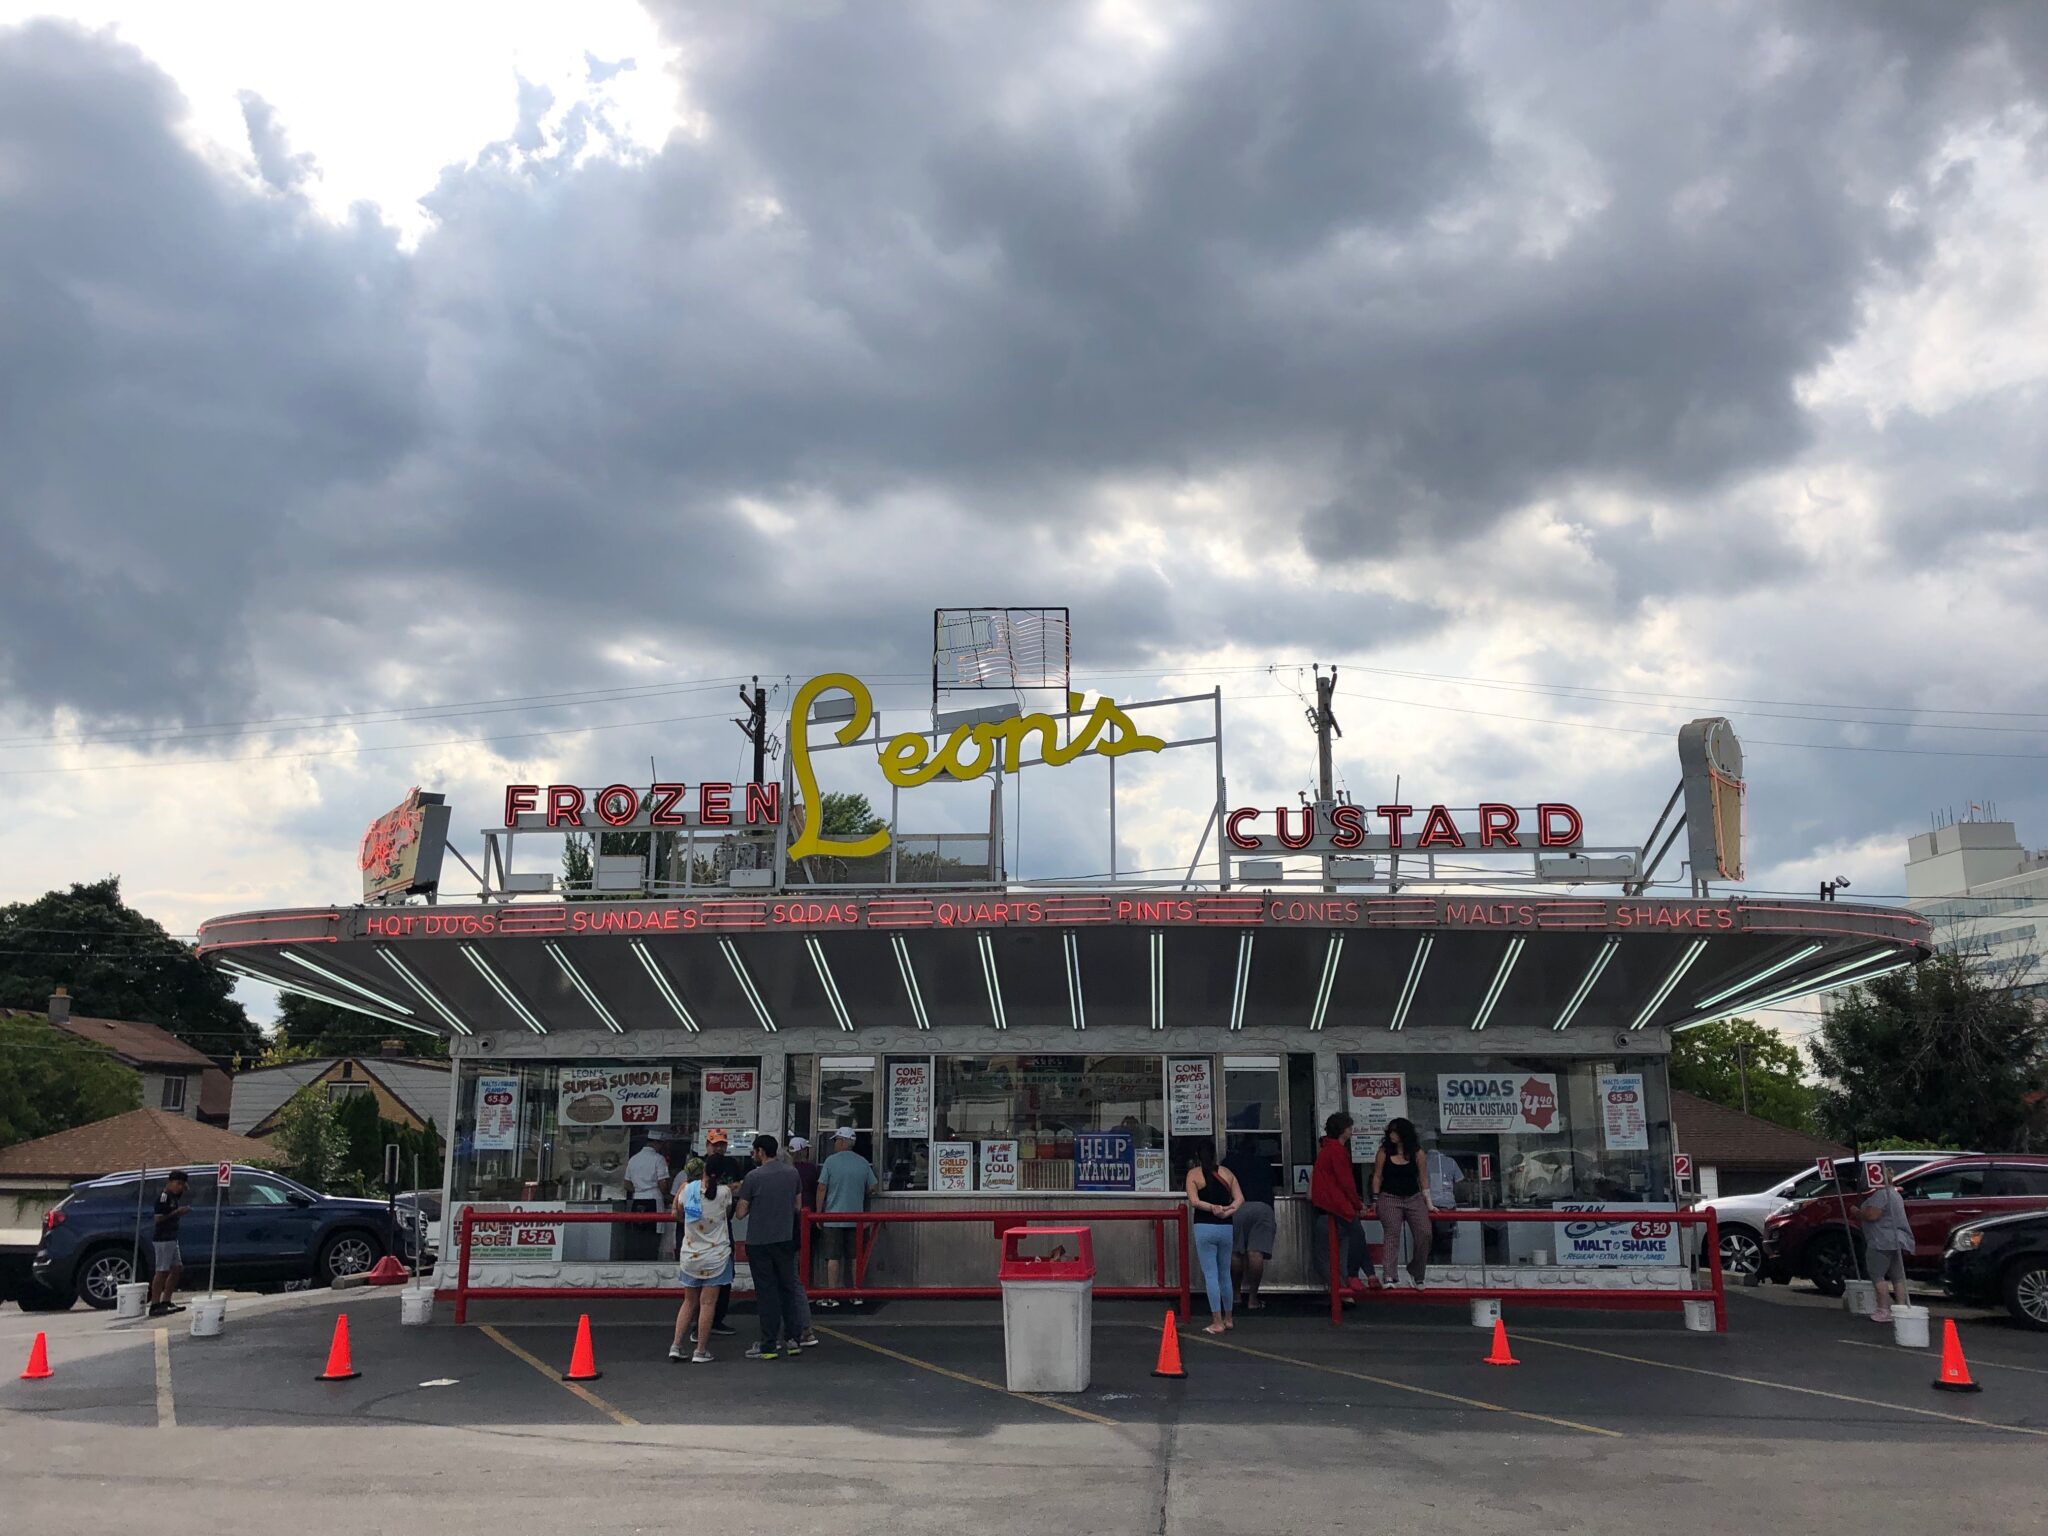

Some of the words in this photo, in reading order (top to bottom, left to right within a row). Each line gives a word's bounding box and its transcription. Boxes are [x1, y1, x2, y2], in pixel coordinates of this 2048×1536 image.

[787, 673, 1163, 861] Leon's
[505, 782, 780, 828] FROZEN
[1226, 802, 1584, 851] CUSTARD
[772, 903, 859, 926] SODAS
[937, 902, 1042, 927] QUARTS
[1116, 900, 1193, 923] PINTS
[1271, 900, 1359, 923] CONES
[1444, 902, 1533, 926] MALTS
[1615, 905, 1733, 930] SHAKES
[366, 914, 411, 938] HOT
[424, 914, 496, 936] DOGS
[572, 908, 697, 933] SUNDAES
[571, 1069, 605, 1079] LEON'S
[895, 1067, 923, 1076] CONE
[1176, 1064, 1203, 1073] CONE
[562, 1077, 608, 1097] SUPER
[609, 1072, 671, 1091] SUNDAE
[720, 1081, 750, 1090] FLAVORS
[723, 1074, 746, 1082] CONE
[894, 1076, 926, 1086] PRICES
[1174, 1072, 1206, 1083] PRICES
[1369, 1079, 1394, 1088] CONE
[615, 1087, 665, 1103] Special
[1366, 1087, 1400, 1096] FLAVORS
[1446, 1080, 1515, 1097] SODAS
[1443, 1102, 1477, 1116] FROZEN
[1479, 1102, 1518, 1116] CUSTARD
[1521, 1092, 1553, 1116] $4.40
[625, 1105, 656, 1121] $7.50
[987, 1144, 997, 1153] WE
[1080, 1138, 1127, 1160] HELP
[939, 1158, 969, 1167] GRILLED
[992, 1153, 1009, 1163] ICE
[1136, 1158, 1164, 1169] GIFT
[220, 1164, 230, 1183] 2
[939, 1167, 965, 1175] CHEESE
[984, 1164, 1015, 1173] COLD
[1078, 1163, 1131, 1181] WANTED
[1482, 1157, 1490, 1177] 1
[1676, 1157, 1689, 1176] 2
[1821, 1160, 1832, 1176] 4
[1869, 1164, 1884, 1184] 3
[1298, 1169, 1310, 1183] A
[1634, 1221, 1667, 1237] $5.50
[521, 1230, 552, 1245] $5.19
[1573, 1240, 1612, 1251] MALT
[1622, 1240, 1667, 1251] SHAKE
